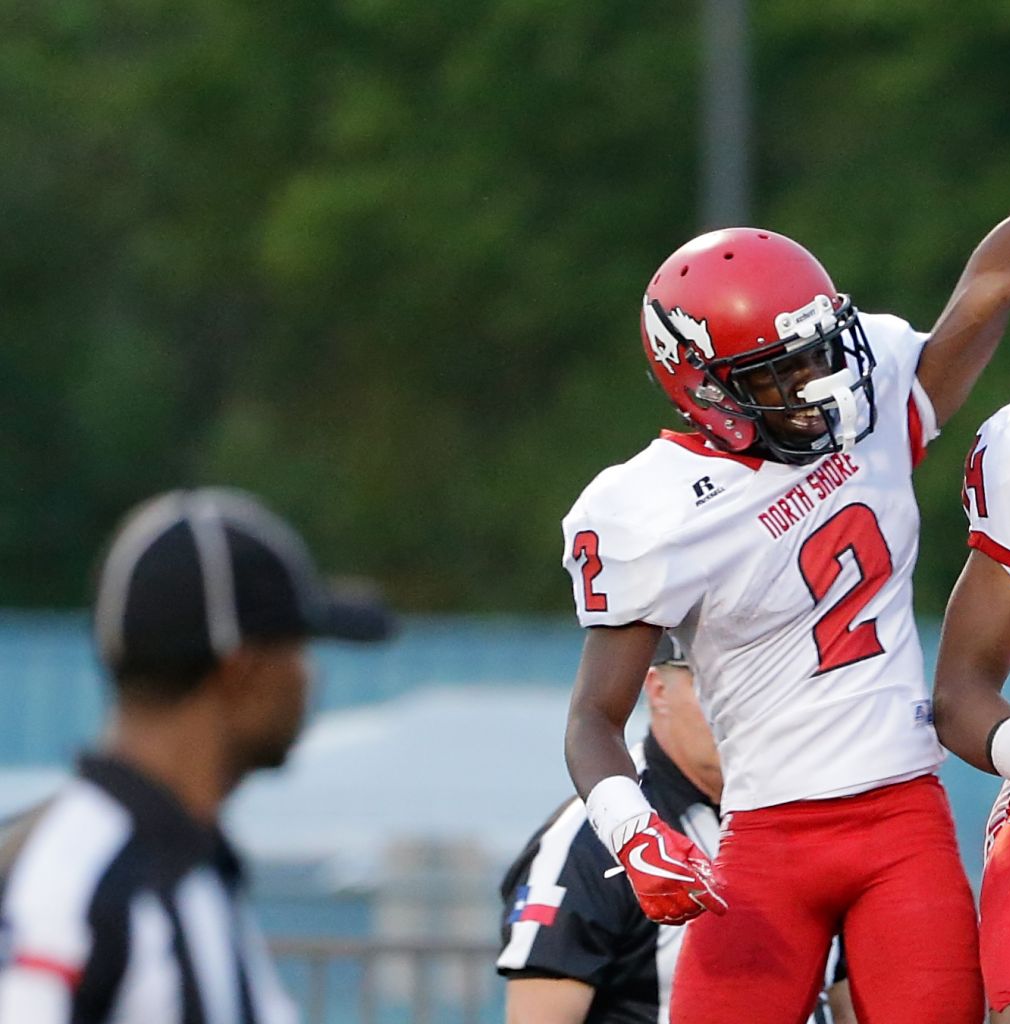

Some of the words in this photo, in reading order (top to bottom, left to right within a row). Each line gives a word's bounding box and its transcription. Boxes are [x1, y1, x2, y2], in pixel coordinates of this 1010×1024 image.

[757, 483, 816, 540] NORTH
[805, 452, 860, 501] SHORE
[572, 529, 608, 613] 2
[797, 501, 894, 678] 2
